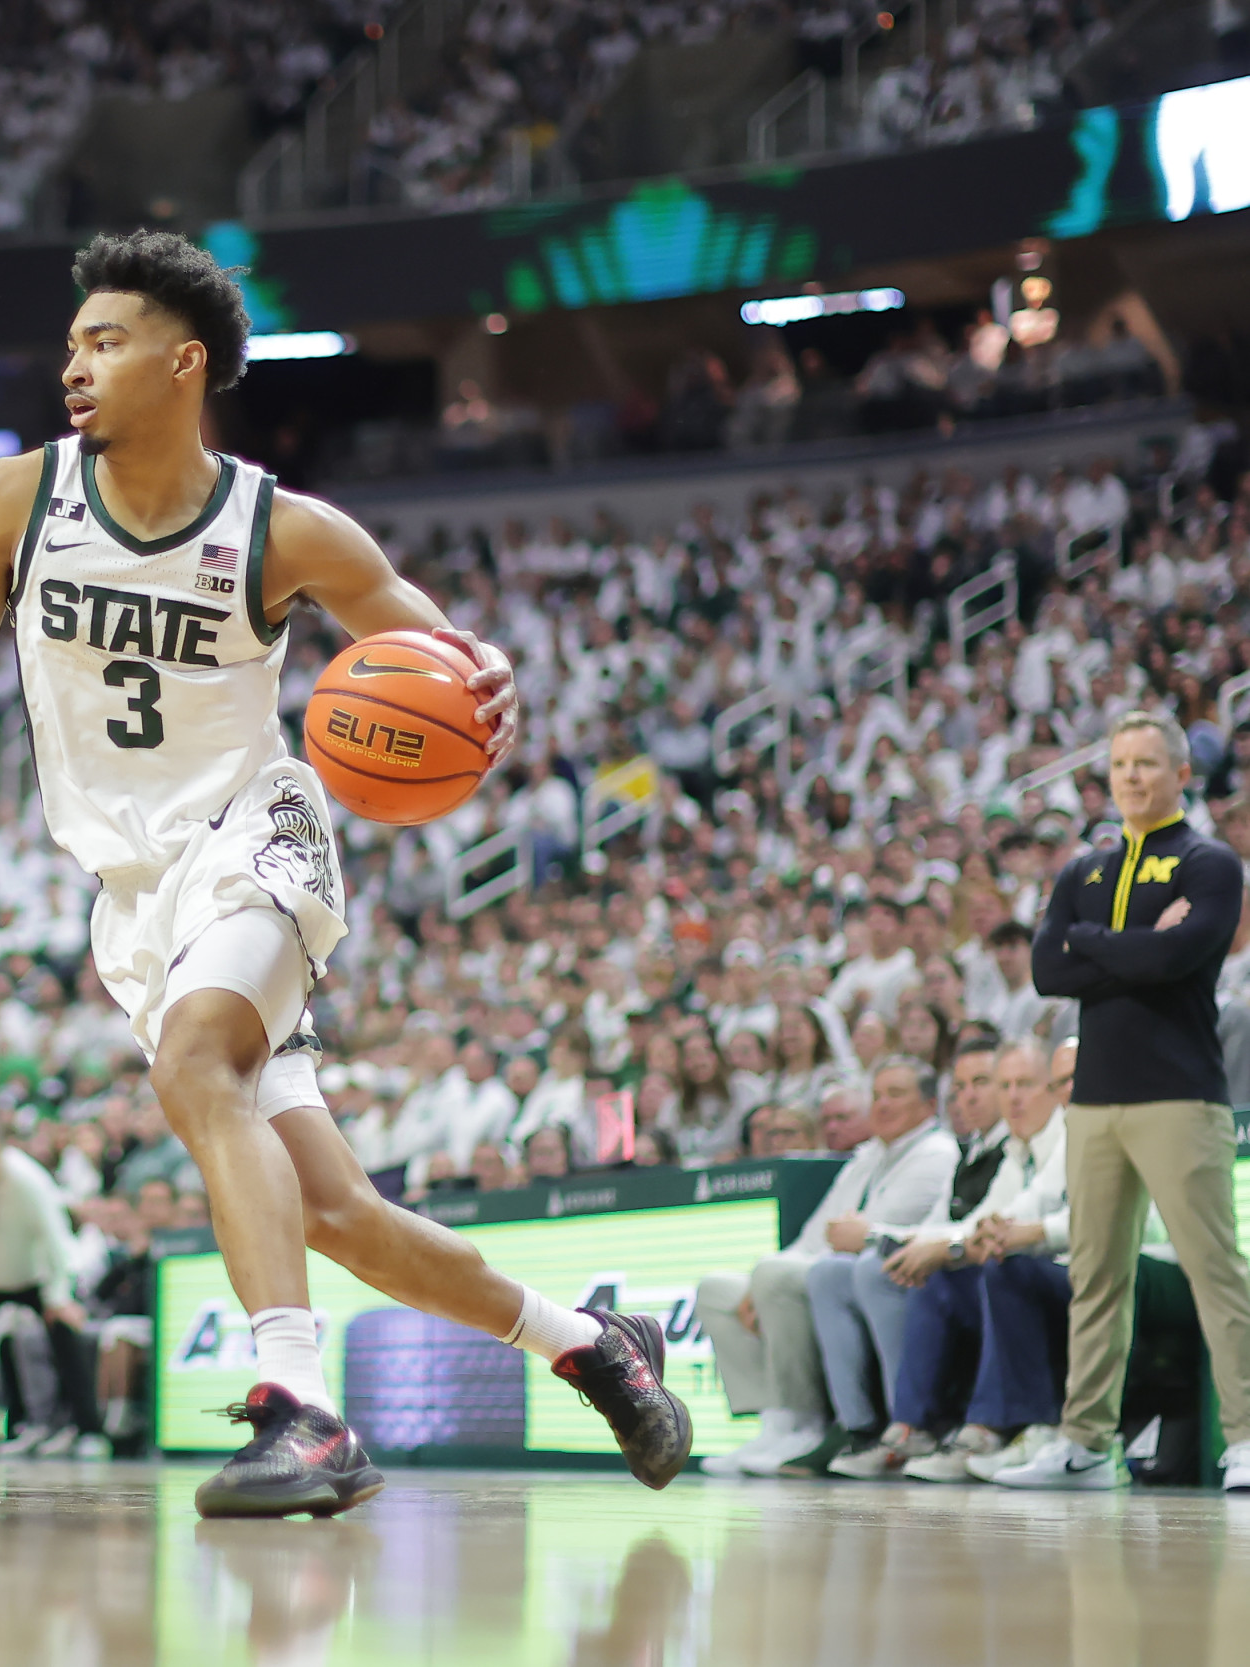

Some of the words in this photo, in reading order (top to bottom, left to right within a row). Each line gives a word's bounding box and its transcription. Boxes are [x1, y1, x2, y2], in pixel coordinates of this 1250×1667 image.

[55, 500, 79, 518] JF
[40, 578, 232, 667] STATE
[103, 660, 164, 749] 3
[324, 735, 421, 768] CHAMPIONSHIP
[326, 706, 426, 761] ELITE
